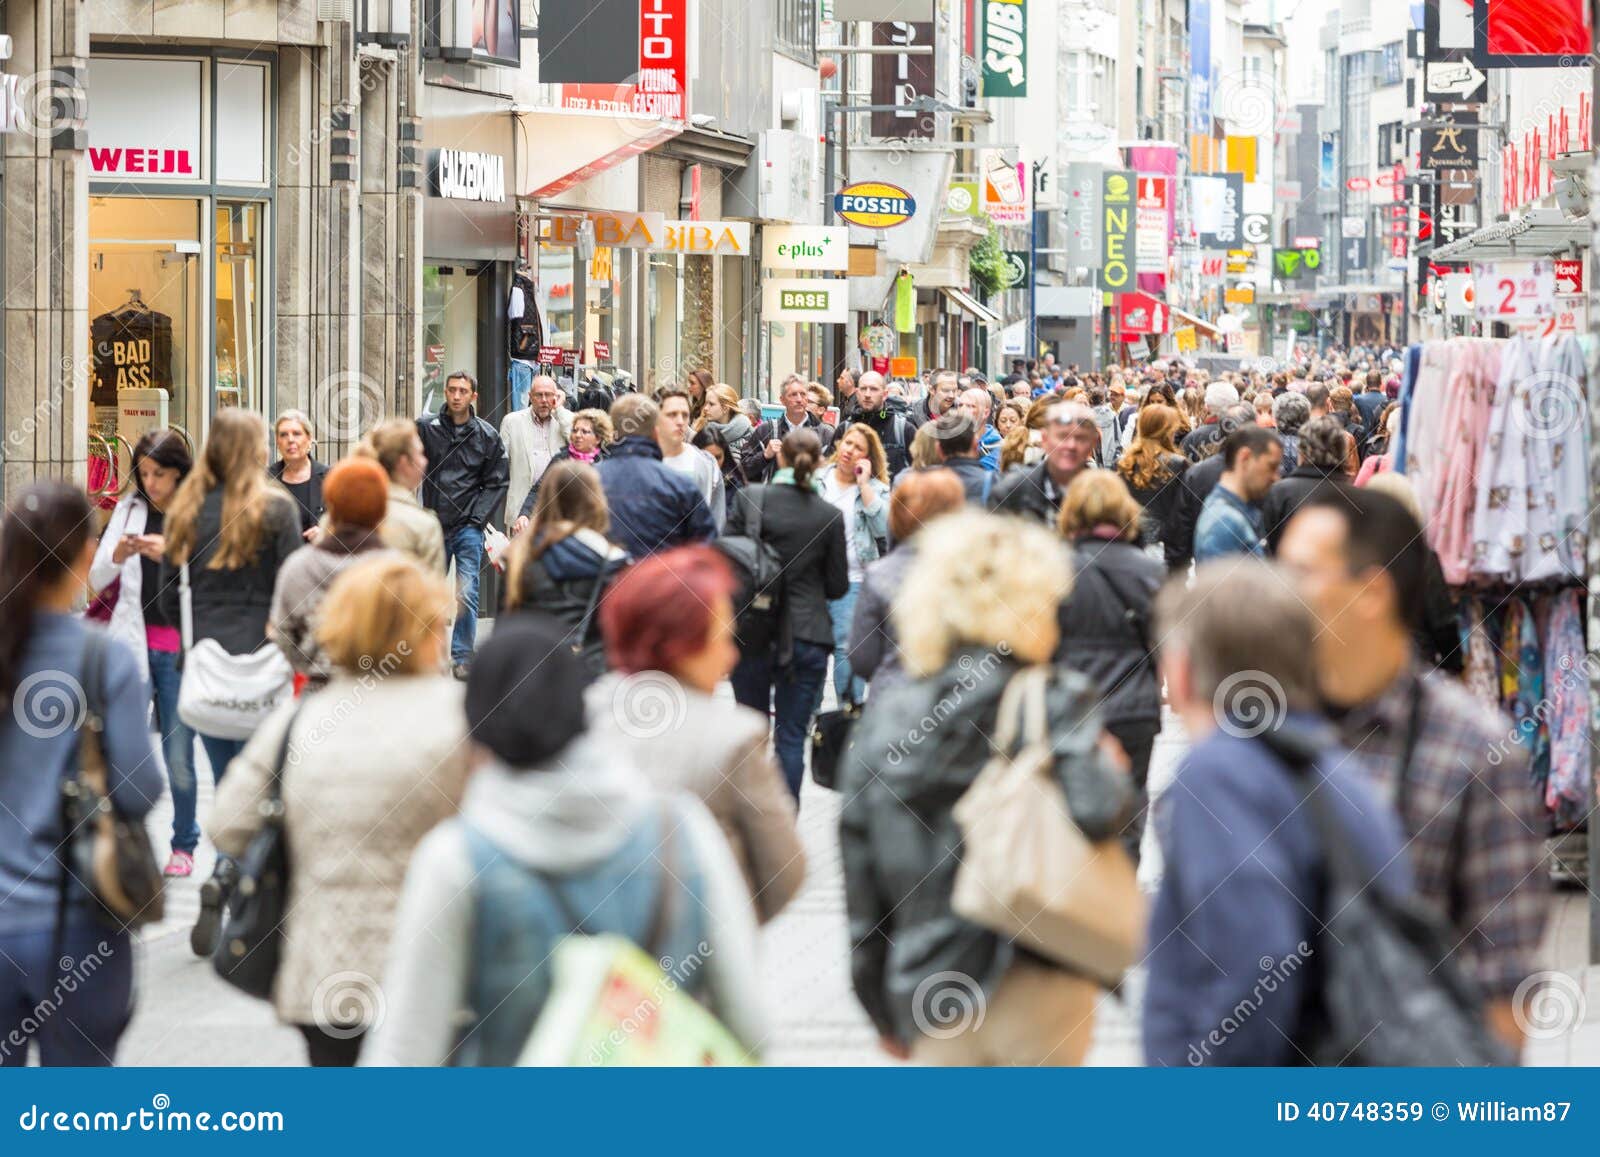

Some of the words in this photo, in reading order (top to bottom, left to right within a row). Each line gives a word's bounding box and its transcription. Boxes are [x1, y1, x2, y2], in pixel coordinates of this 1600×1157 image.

[638, 68, 678, 92] YOUNG
[633, 93, 682, 118] FASHION
[439, 147, 506, 203] CALZEDONIA
[842, 196, 910, 215] FOSSIL
[555, 215, 655, 244] BBA
[1104, 207, 1129, 288] NEO
[784, 293, 826, 308] BASE
[1498, 278, 1517, 315] 2
[113, 339, 151, 366] BAD
